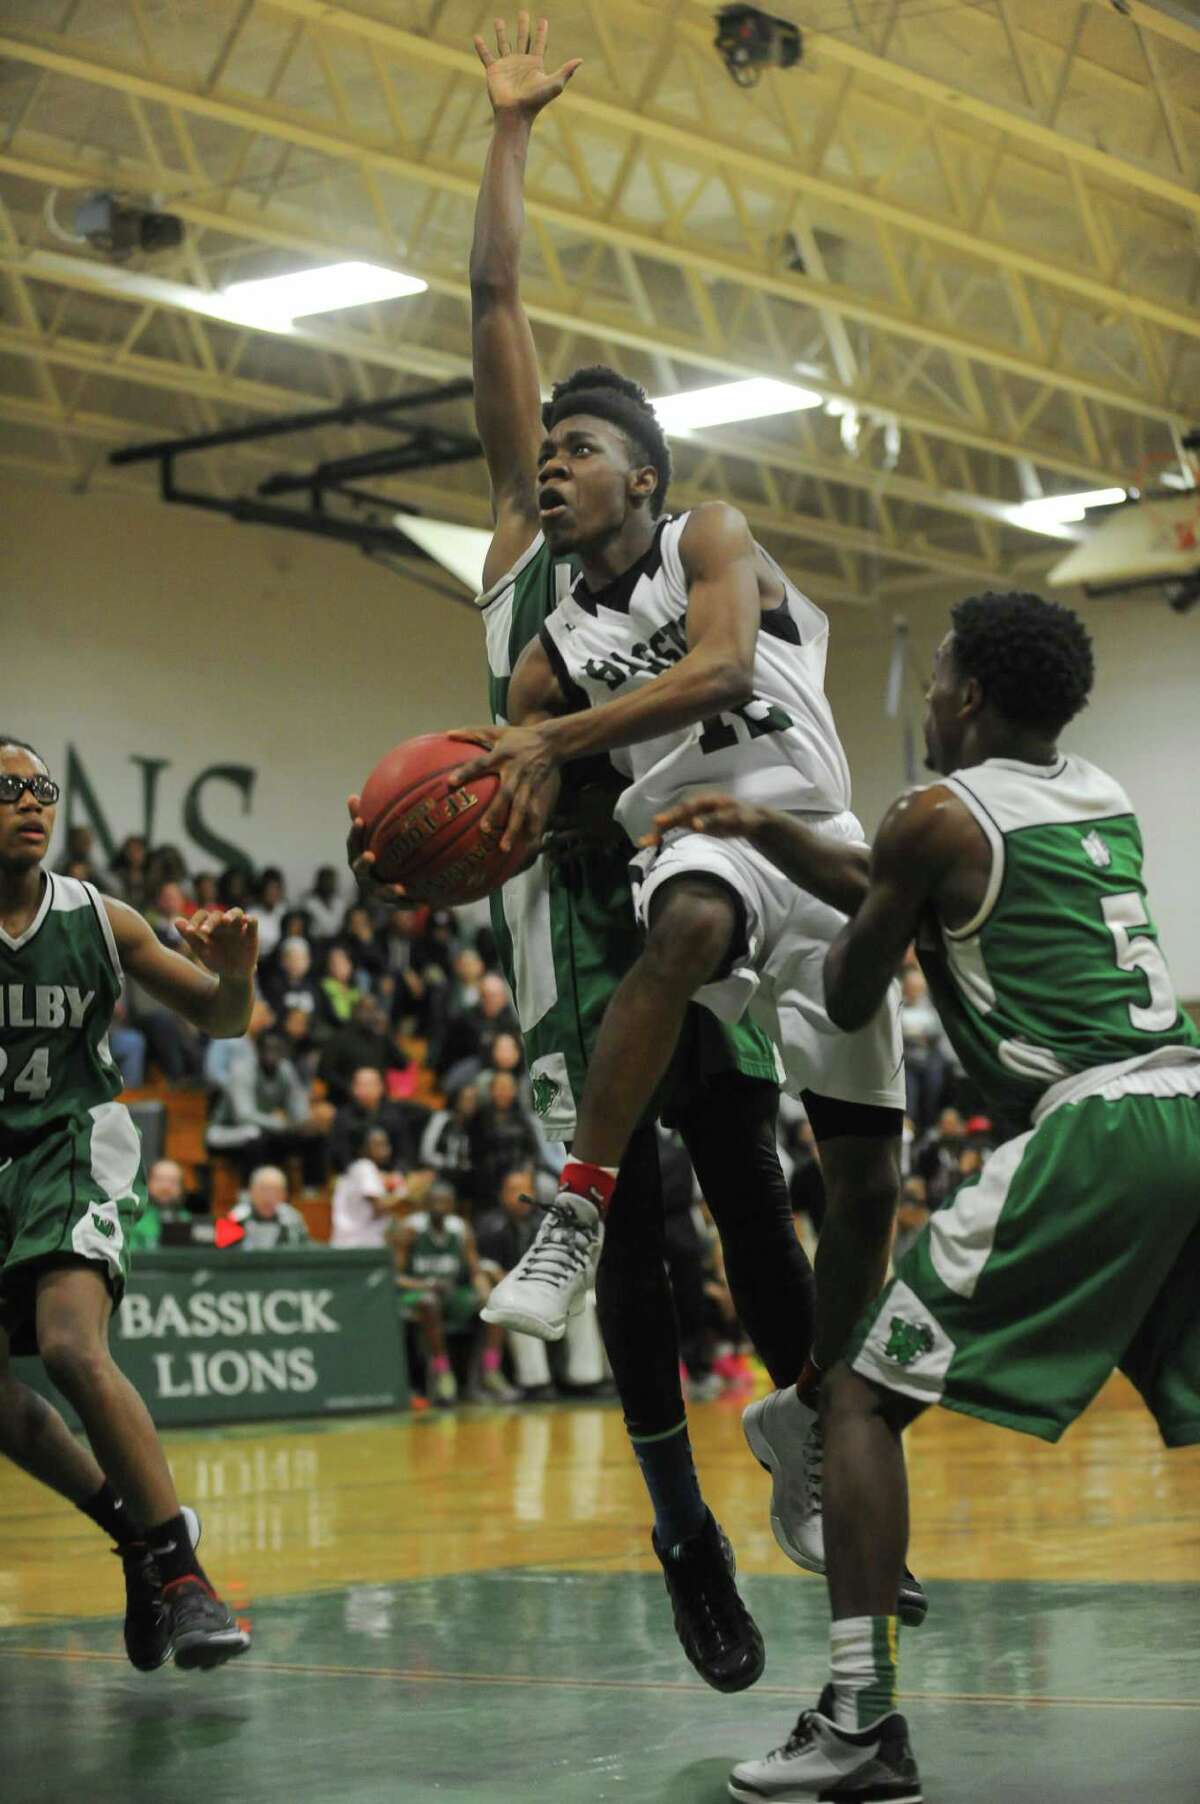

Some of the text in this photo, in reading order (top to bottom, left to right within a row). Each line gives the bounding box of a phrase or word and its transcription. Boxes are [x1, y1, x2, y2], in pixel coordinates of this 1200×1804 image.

[1100, 891, 1178, 1032] 5
[0, 983, 96, 1029] LBY
[0, 1045, 52, 1101] 4
[118, 1288, 341, 1340] BASSICK
[154, 1346, 319, 1398] LIONS
